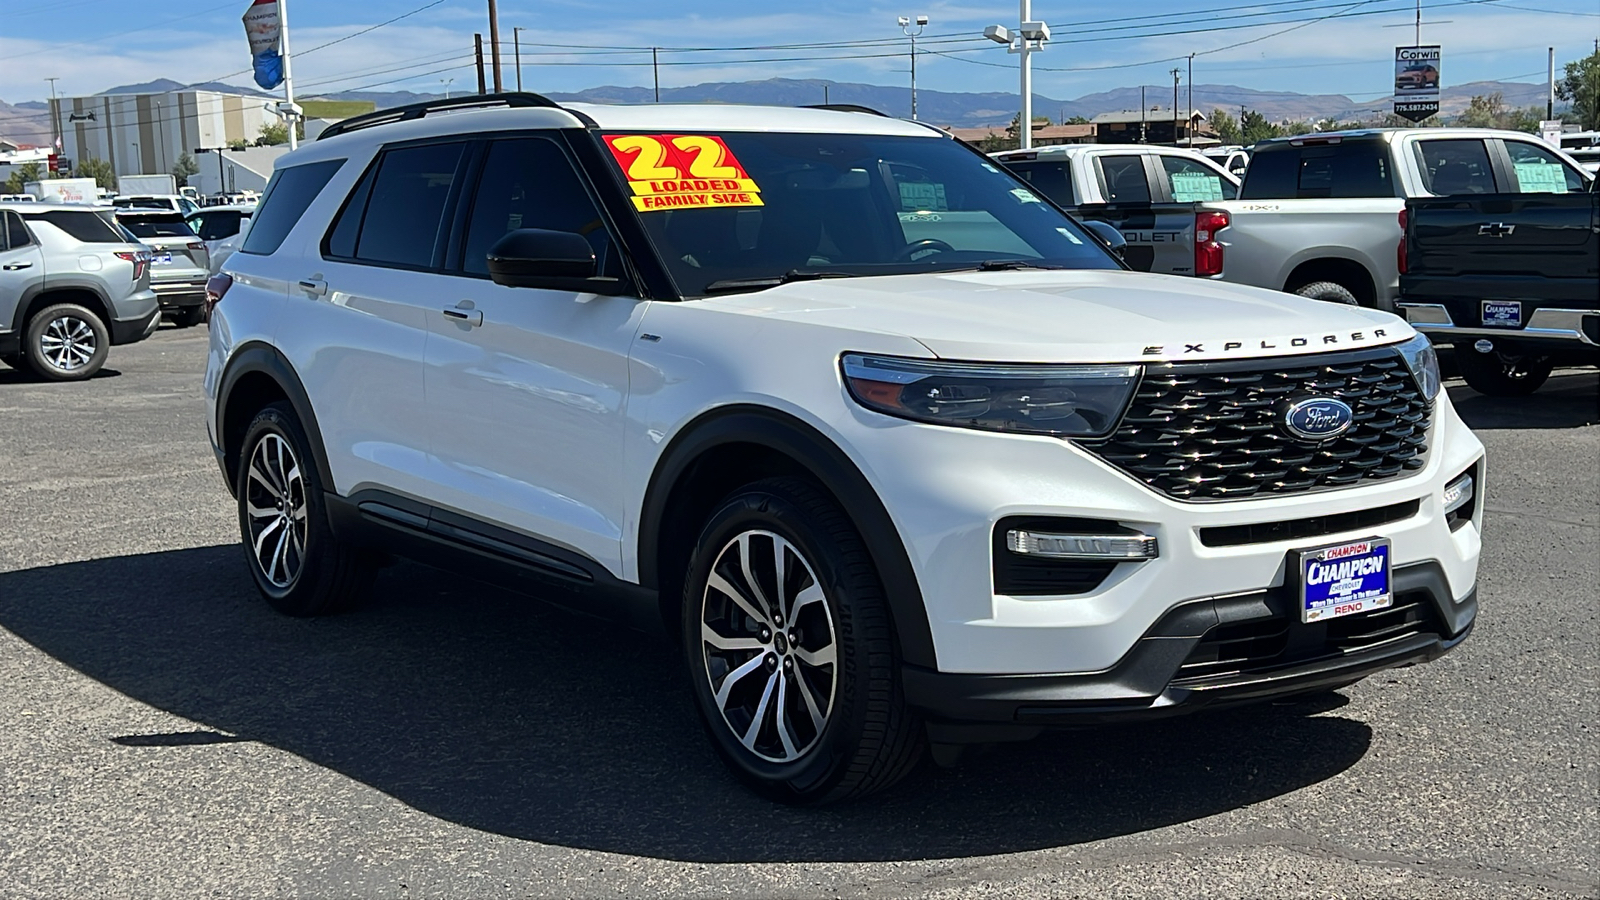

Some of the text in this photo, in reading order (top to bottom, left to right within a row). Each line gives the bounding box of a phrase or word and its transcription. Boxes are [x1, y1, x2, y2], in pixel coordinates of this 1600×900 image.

[1400, 50, 1439, 60] Corwin
[611, 135, 742, 180] 22
[650, 180, 741, 193] LOADED
[642, 193, 752, 209] FAMILY SIZE
[1124, 231, 1181, 242] OLET
[1485, 304, 1519, 314] CHAMPION
[1142, 328, 1387, 355] EXPLORER
[1305, 406, 1340, 430] Ford
[1326, 543, 1367, 559] CHAMPION
[1307, 556, 1383, 585] CHAMPION
[1331, 580, 1361, 592] CHEVROLET
[1335, 602, 1363, 615] RENO
